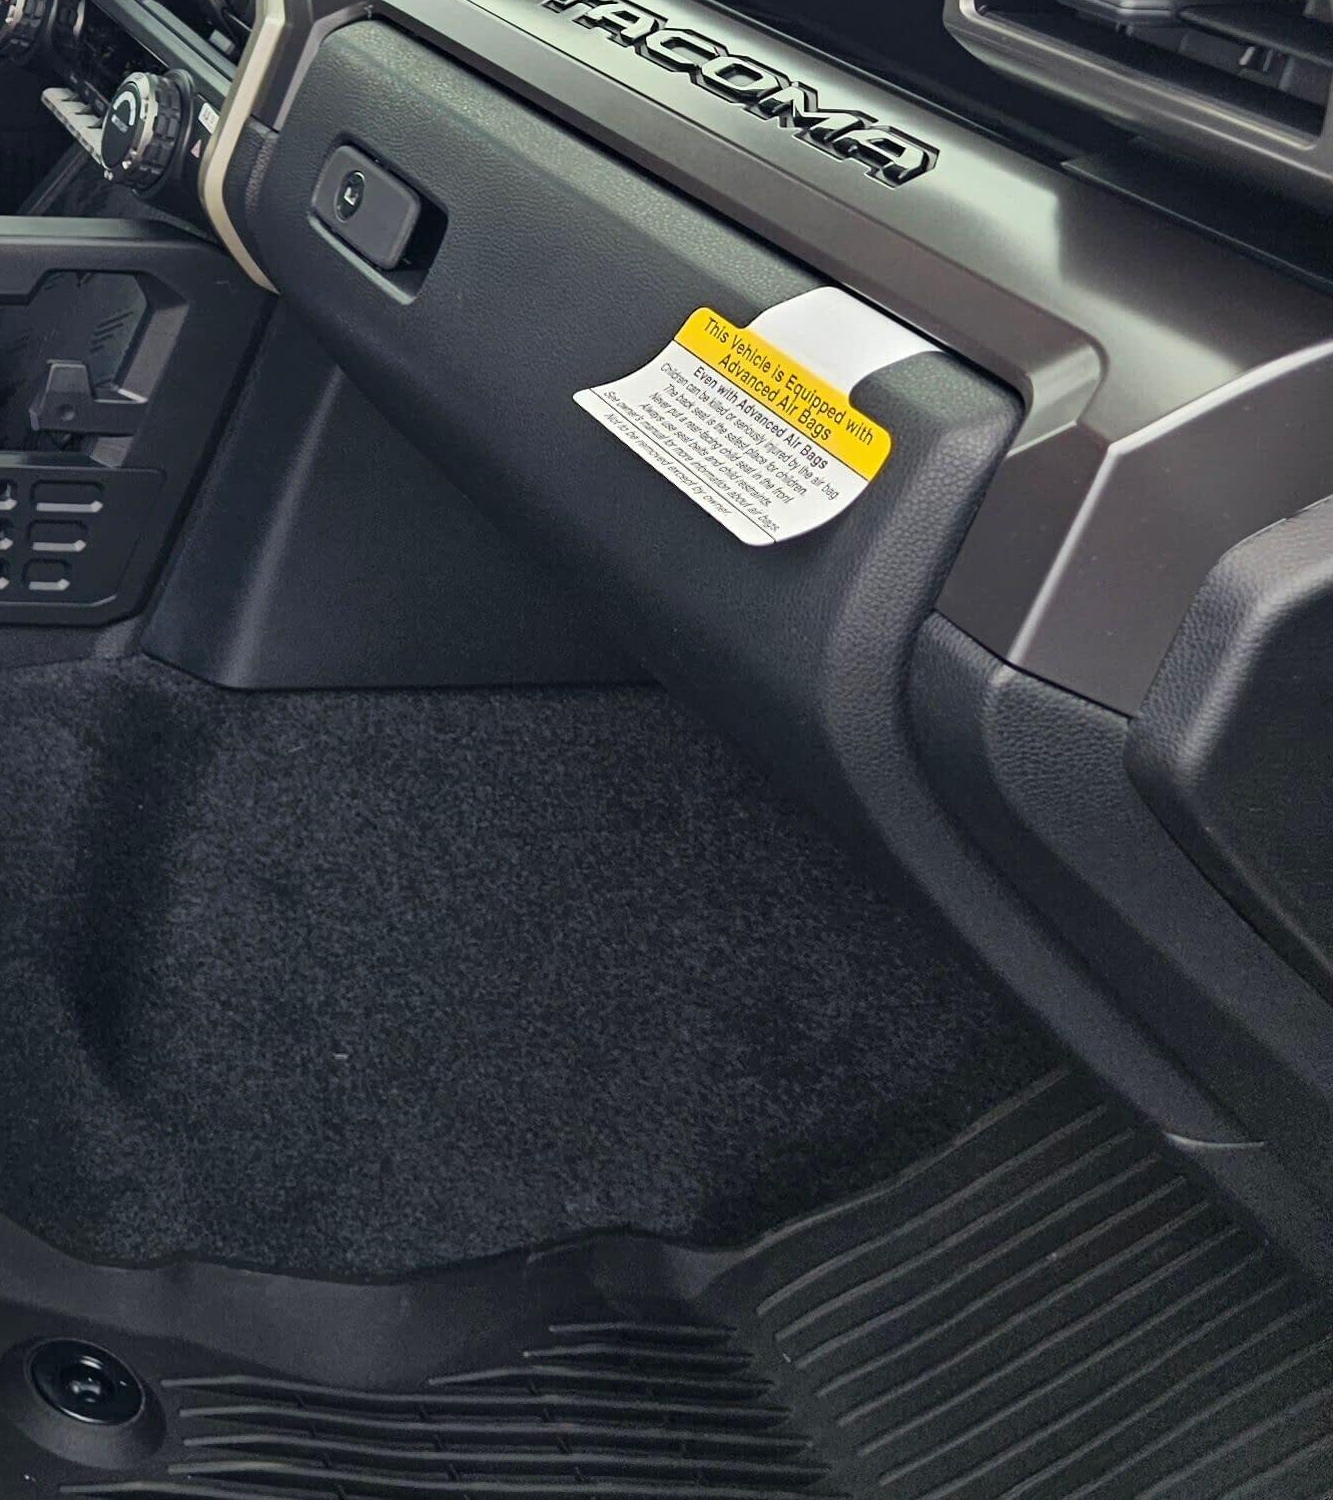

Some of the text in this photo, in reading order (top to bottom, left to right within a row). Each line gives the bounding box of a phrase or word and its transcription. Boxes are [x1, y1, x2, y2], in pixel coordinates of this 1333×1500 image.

[664, 383, 679, 397] The
[676, 393, 694, 408] back
[691, 406, 711, 421] seat
[713, 422, 728, 435] the
[725, 432, 752, 451] safest
[744, 447, 768, 465] place
[766, 461, 779, 473] for
[693, 366, 829, 470] Even with Advanced Air Bags
[703, 316, 874, 446] This Vehicle is Equipped with
[718, 353, 832, 441] Advanced Air Bags
[638, 402, 665, 423] Always
[661, 421, 678, 432] use
[673, 430, 694, 443] seat
[704, 454, 724, 468] and
[719, 466, 741, 481] child
[649, 391, 673, 410] Never
[667, 407, 684, 419] put
[719, 447, 741, 462] child
[735, 460, 758, 474] seat
[759, 477, 776, 490] the
[660, 362, 840, 501] Children can be killed or seriously injured by the air bag
